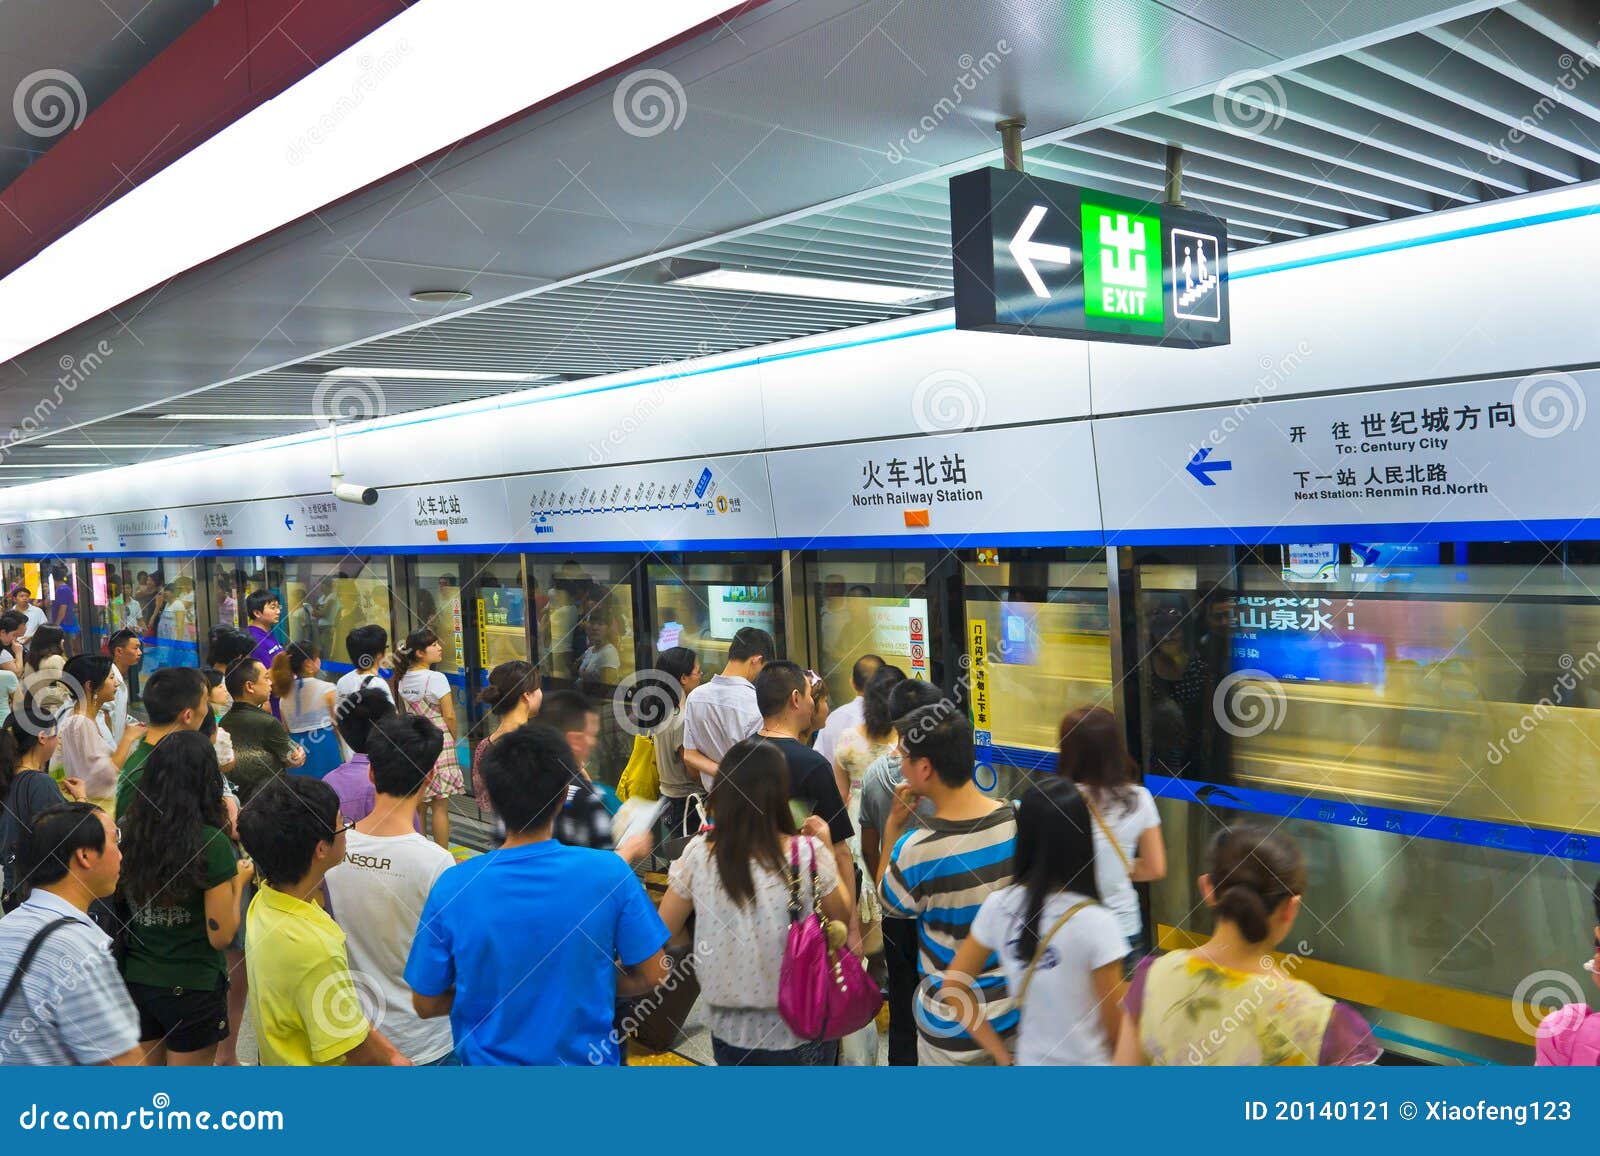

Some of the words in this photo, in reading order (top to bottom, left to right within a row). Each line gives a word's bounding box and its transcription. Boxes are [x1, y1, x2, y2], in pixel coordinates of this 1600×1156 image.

[1099, 213, 1147, 288] 出
[1102, 287, 1147, 316] EXIT
[1289, 425, 1307, 443] 开
[1331, 421, 1351, 440] 往
[1360, 401, 1516, 438] 世纪城方向
[1336, 443, 1357, 454] To:
[1360, 440, 1415, 453] Century
[1419, 437, 1449, 450] City
[862, 453, 967, 490] 火车北站
[1293, 468, 1357, 488] 下一站
[1364, 463, 1448, 486] 人民北路
[417, 495, 462, 516] 火车北站
[852, 493, 884, 506] North
[886, 490, 933, 505] Railway
[936, 488, 983, 502] Station
[1294, 490, 1319, 500] Next
[1320, 489, 1363, 500] Station:
[1365, 486, 1418, 498] Renmin
